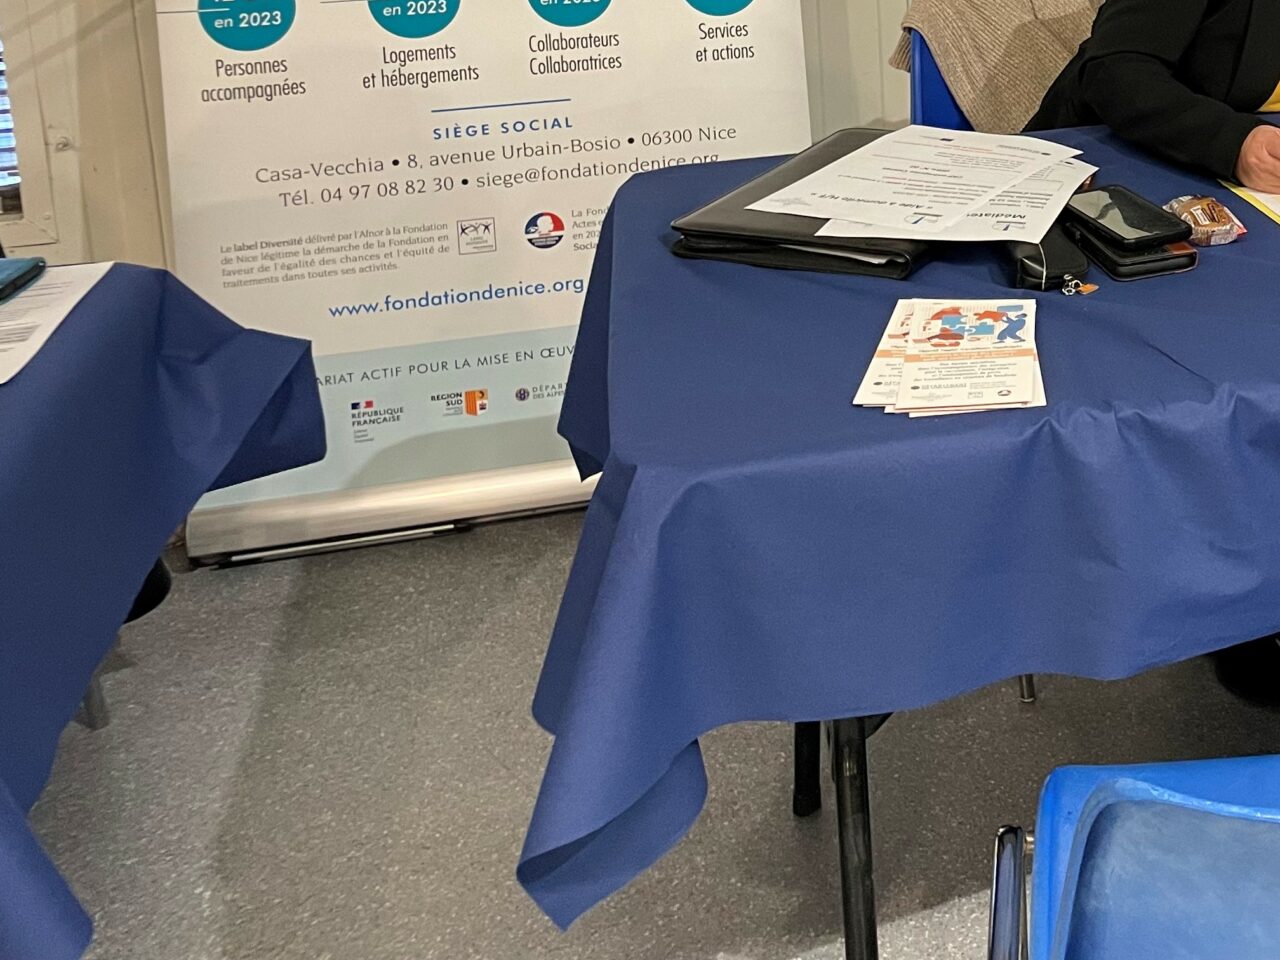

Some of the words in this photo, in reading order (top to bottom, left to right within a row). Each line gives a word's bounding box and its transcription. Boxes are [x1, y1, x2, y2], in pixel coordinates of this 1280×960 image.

[214, 18, 233, 28] en
[238, 10, 281, 27] 2023
[382, 6, 401, 16] en
[406, 0, 447, 15] 2023
[528, 31, 619, 52] Collaborateurs
[698, 21, 748, 40] Services
[382, 43, 456, 67] Logements
[695, 46, 707, 62] et
[711, 43, 754, 61] actions
[215, 58, 288, 77] Personnes
[529, 53, 622, 75] Collaboratrices
[362, 72, 376, 88] et
[380, 64, 479, 88] hébergements
[200, 77, 306, 103] accompagnées
[432, 122, 489, 140] SIÈGE
[500, 116, 572, 134] SOCIAL
[255, 157, 384, 183] Casa-Vecchia
[407, 153, 422, 168] 8,
[429, 149, 495, 166] avenue
[501, 135, 620, 159] Urbain-Bosio
[641, 128, 692, 146] 06300
[698, 126, 736, 141] Nice
[278, 188, 313, 207] Tél.
[320, 187, 342, 202] 04
[348, 184, 370, 200] 97
[376, 181, 398, 197] 08
[405, 178, 426, 194] 82
[433, 176, 454, 192] 30
[328, 278, 584, 317] www.fondationdenice.org
[360, 366, 401, 382] ACTIF
[408, 360, 448, 375] POUR
[454, 357, 471, 370] LA
[476, 352, 509, 367] MISE
[515, 349, 533, 362] EN
[532, 383, 567, 392] DÉPAR
[445, 398, 463, 406] SUD
